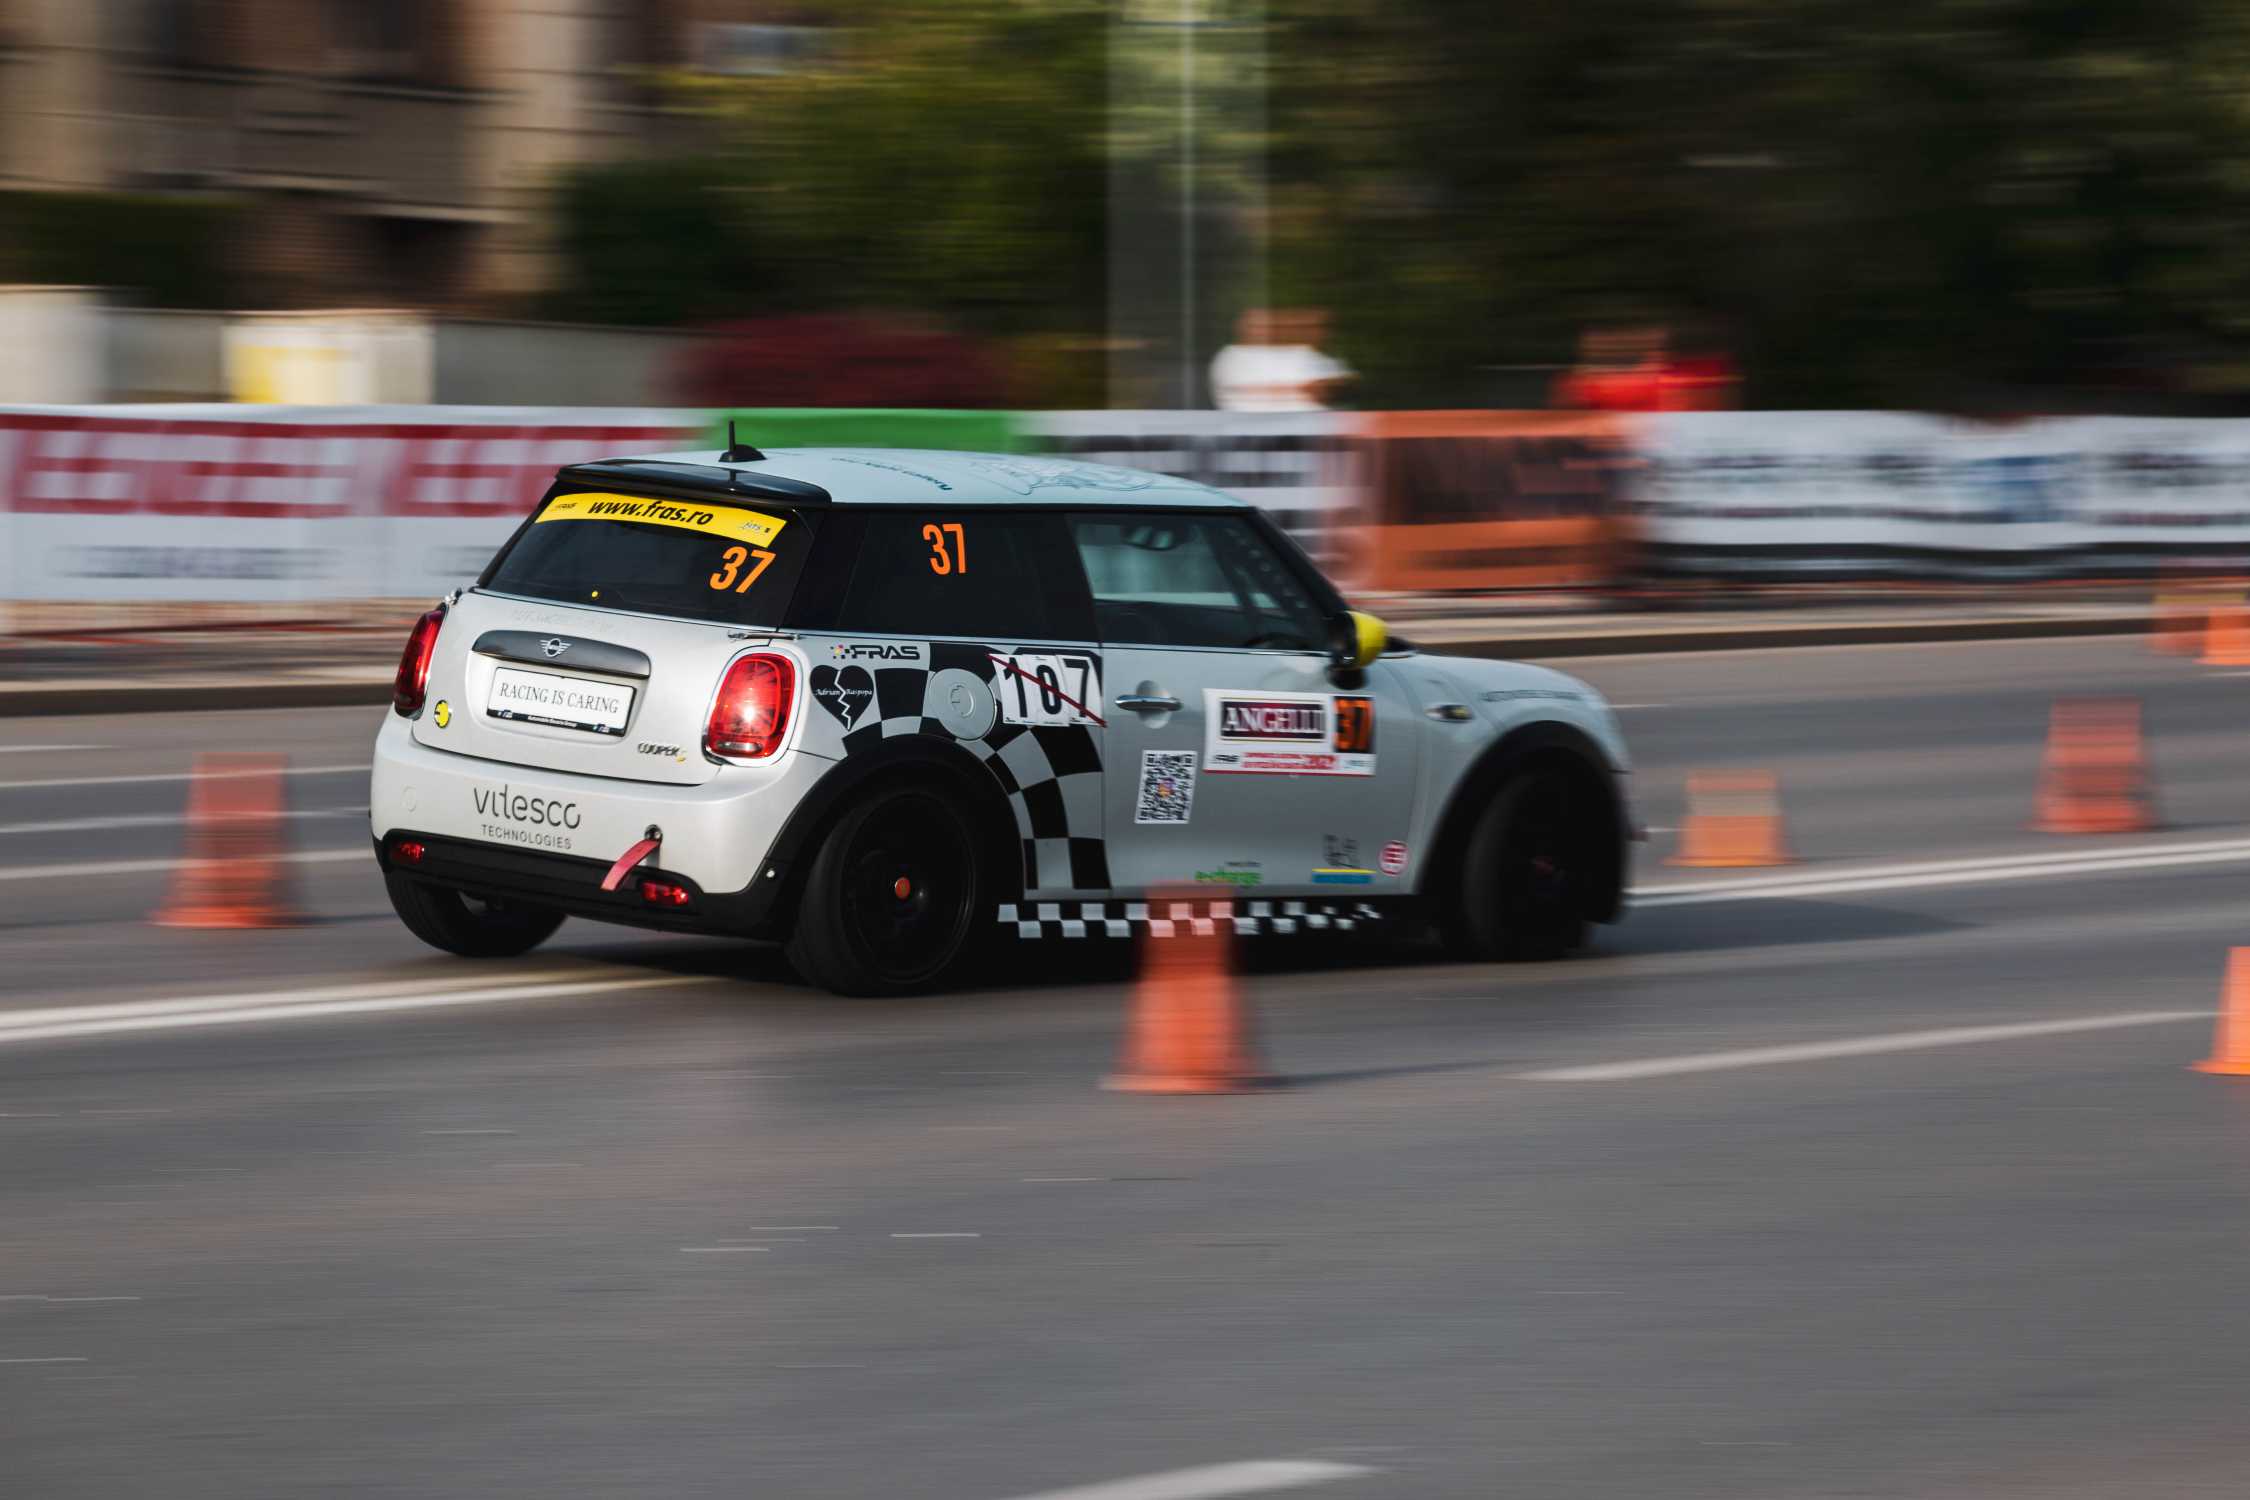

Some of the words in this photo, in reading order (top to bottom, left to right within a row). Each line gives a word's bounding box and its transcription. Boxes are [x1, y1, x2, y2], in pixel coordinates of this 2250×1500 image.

[587, 500, 713, 526] www.fras.ro
[923, 523, 967, 575] 37
[709, 546, 776, 593] 37
[850, 644, 920, 660] FRAS
[500, 682, 548, 704] RACING
[551, 689, 566, 706] IS
[567, 693, 619, 713] CARING
[1003, 657, 1090, 718] 107
[481, 824, 573, 850] TECHNOLOGIES
